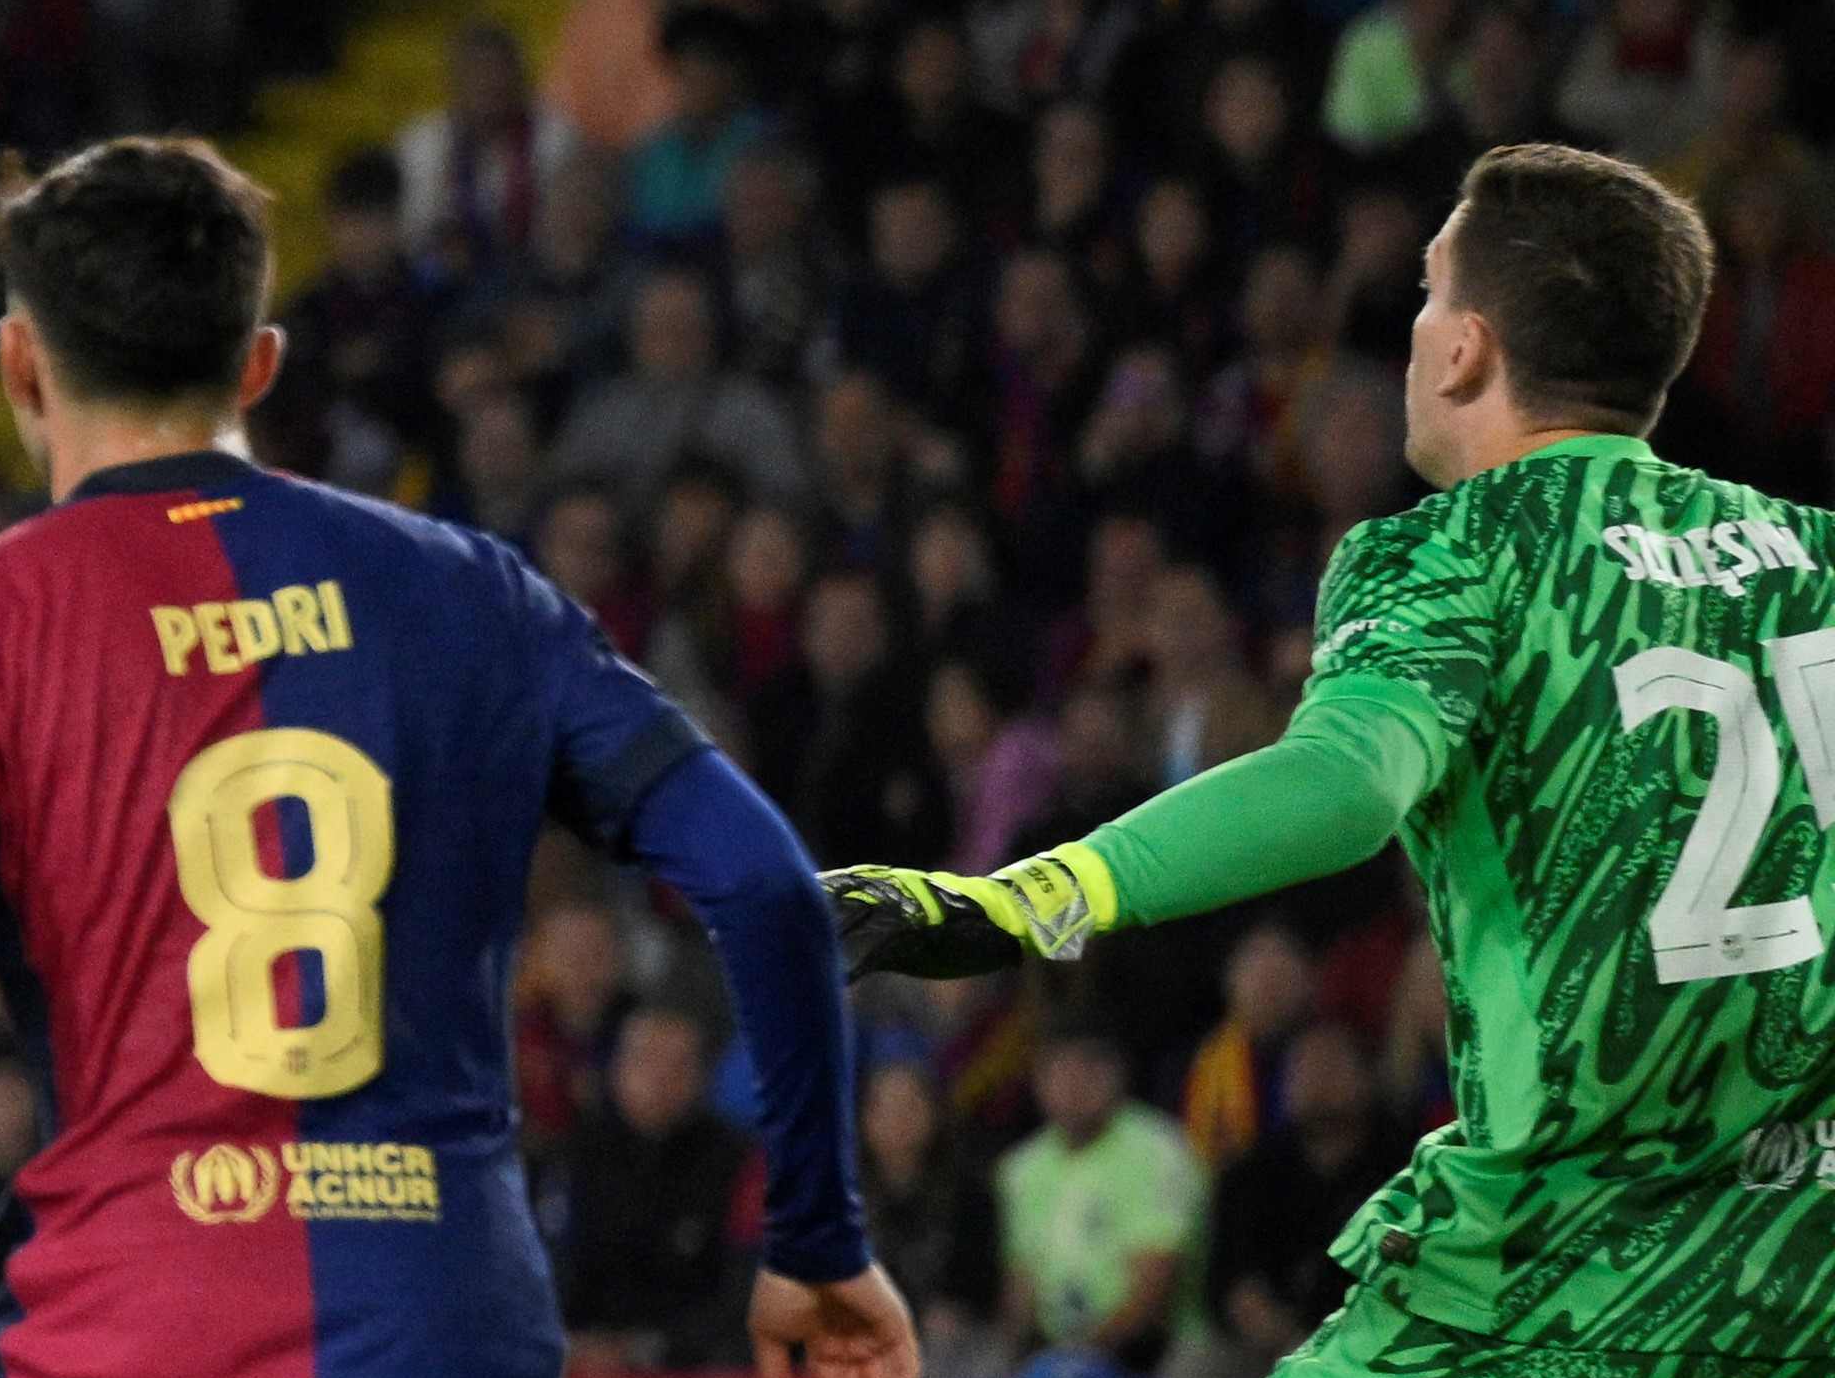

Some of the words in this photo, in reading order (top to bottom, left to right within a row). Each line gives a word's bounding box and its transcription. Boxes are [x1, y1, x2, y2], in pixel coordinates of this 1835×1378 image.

[149, 579, 353, 676] PEDRI
[169, 727, 394, 1099] 8
[282, 1142, 436, 1174] UNHCR
[286, 1175, 440, 1206] ACNUR
